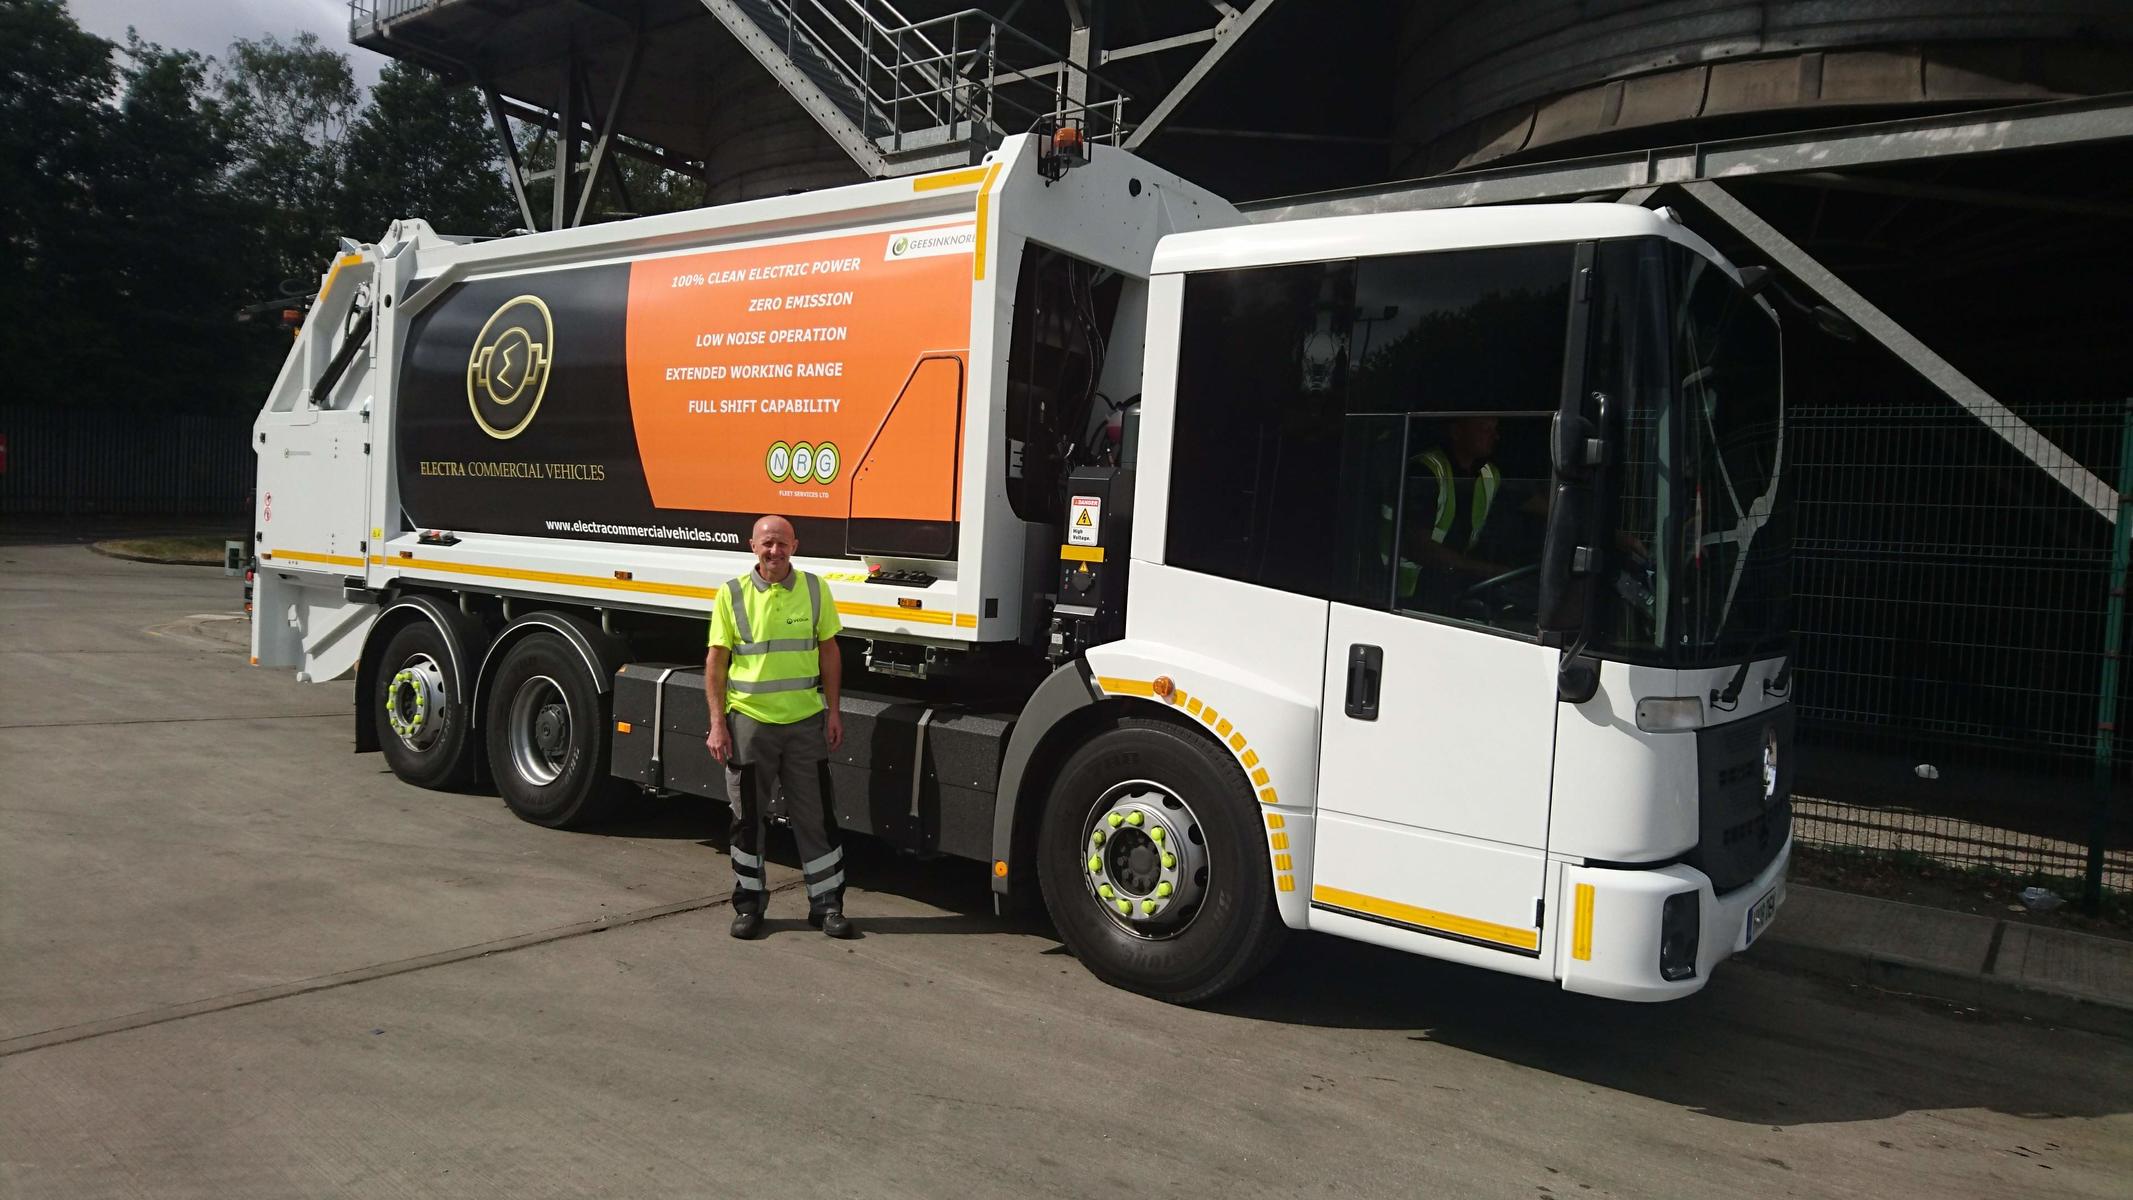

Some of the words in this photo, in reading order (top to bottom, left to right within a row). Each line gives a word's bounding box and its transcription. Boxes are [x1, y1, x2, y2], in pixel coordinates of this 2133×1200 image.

[671, 274, 705, 287] 100%
[707, 269, 746, 284] CLEAN
[748, 263, 809, 281] ELECTRIC
[812, 257, 861, 274] POWER
[748, 297, 782, 312] ZERO
[785, 292, 854, 309] EMISSION
[696, 333, 724, 347] LOW
[726, 331, 766, 345] NOISE
[769, 327, 847, 343] OPERATION
[665, 366, 727, 380] EXTENDED
[730, 364, 793, 379] WORKING
[797, 363, 843, 377] RANGE
[688, 400, 717, 413] FULL
[720, 400, 757, 413] SHIFT
[760, 399, 841, 413] CAPABILITY
[420, 462, 466, 476] ELECTRA
[468, 462, 544, 478] COMMERCIAL
[545, 463, 605, 481] VEHICLES
[545, 520, 739, 544] www.electracommercialvehicles.com
